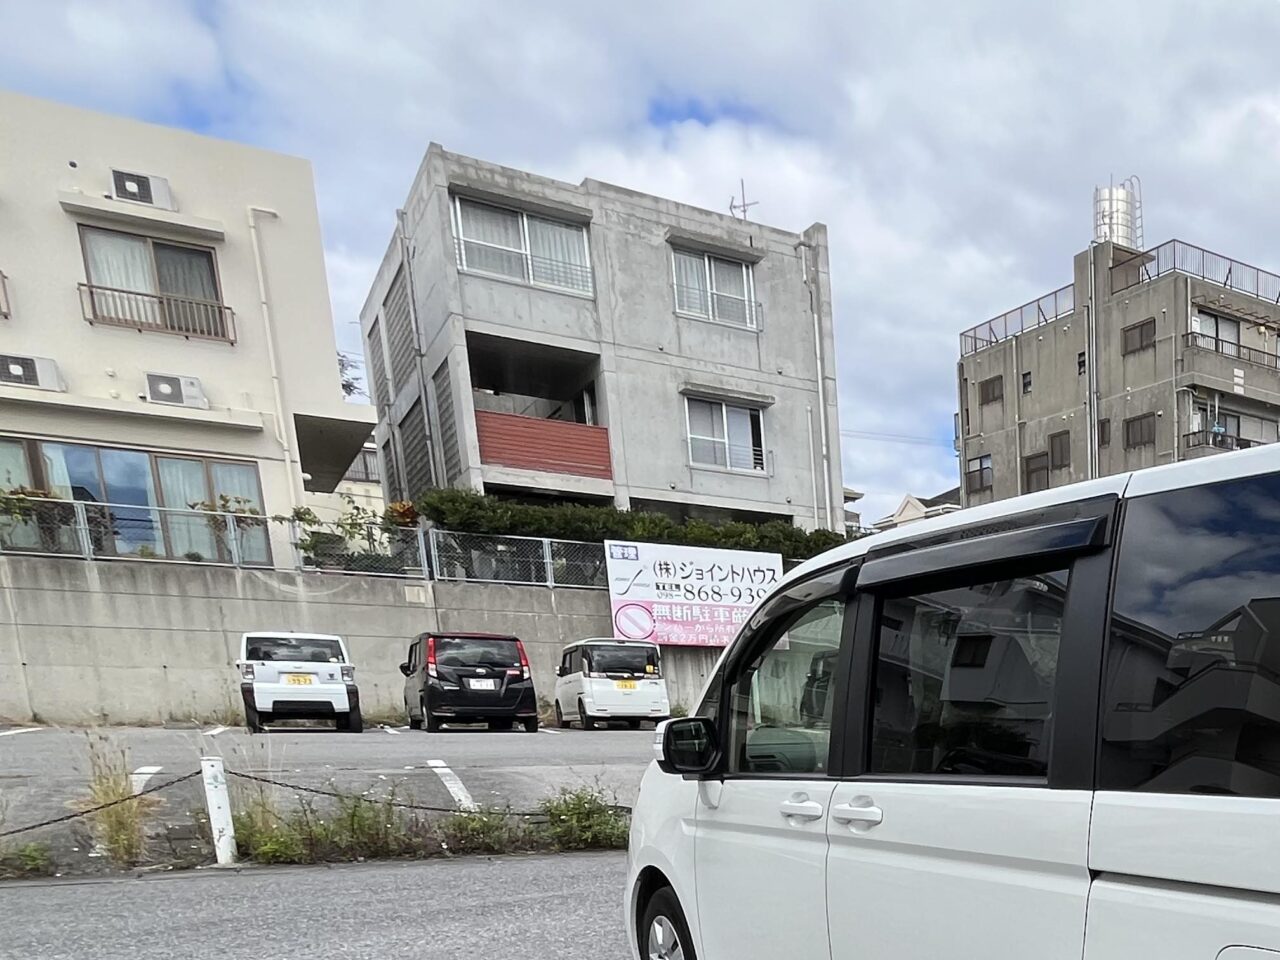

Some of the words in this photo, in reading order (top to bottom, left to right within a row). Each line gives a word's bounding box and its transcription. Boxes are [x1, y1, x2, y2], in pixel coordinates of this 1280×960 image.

[653, 560, 778, 584] (株)ジョイントハウス
